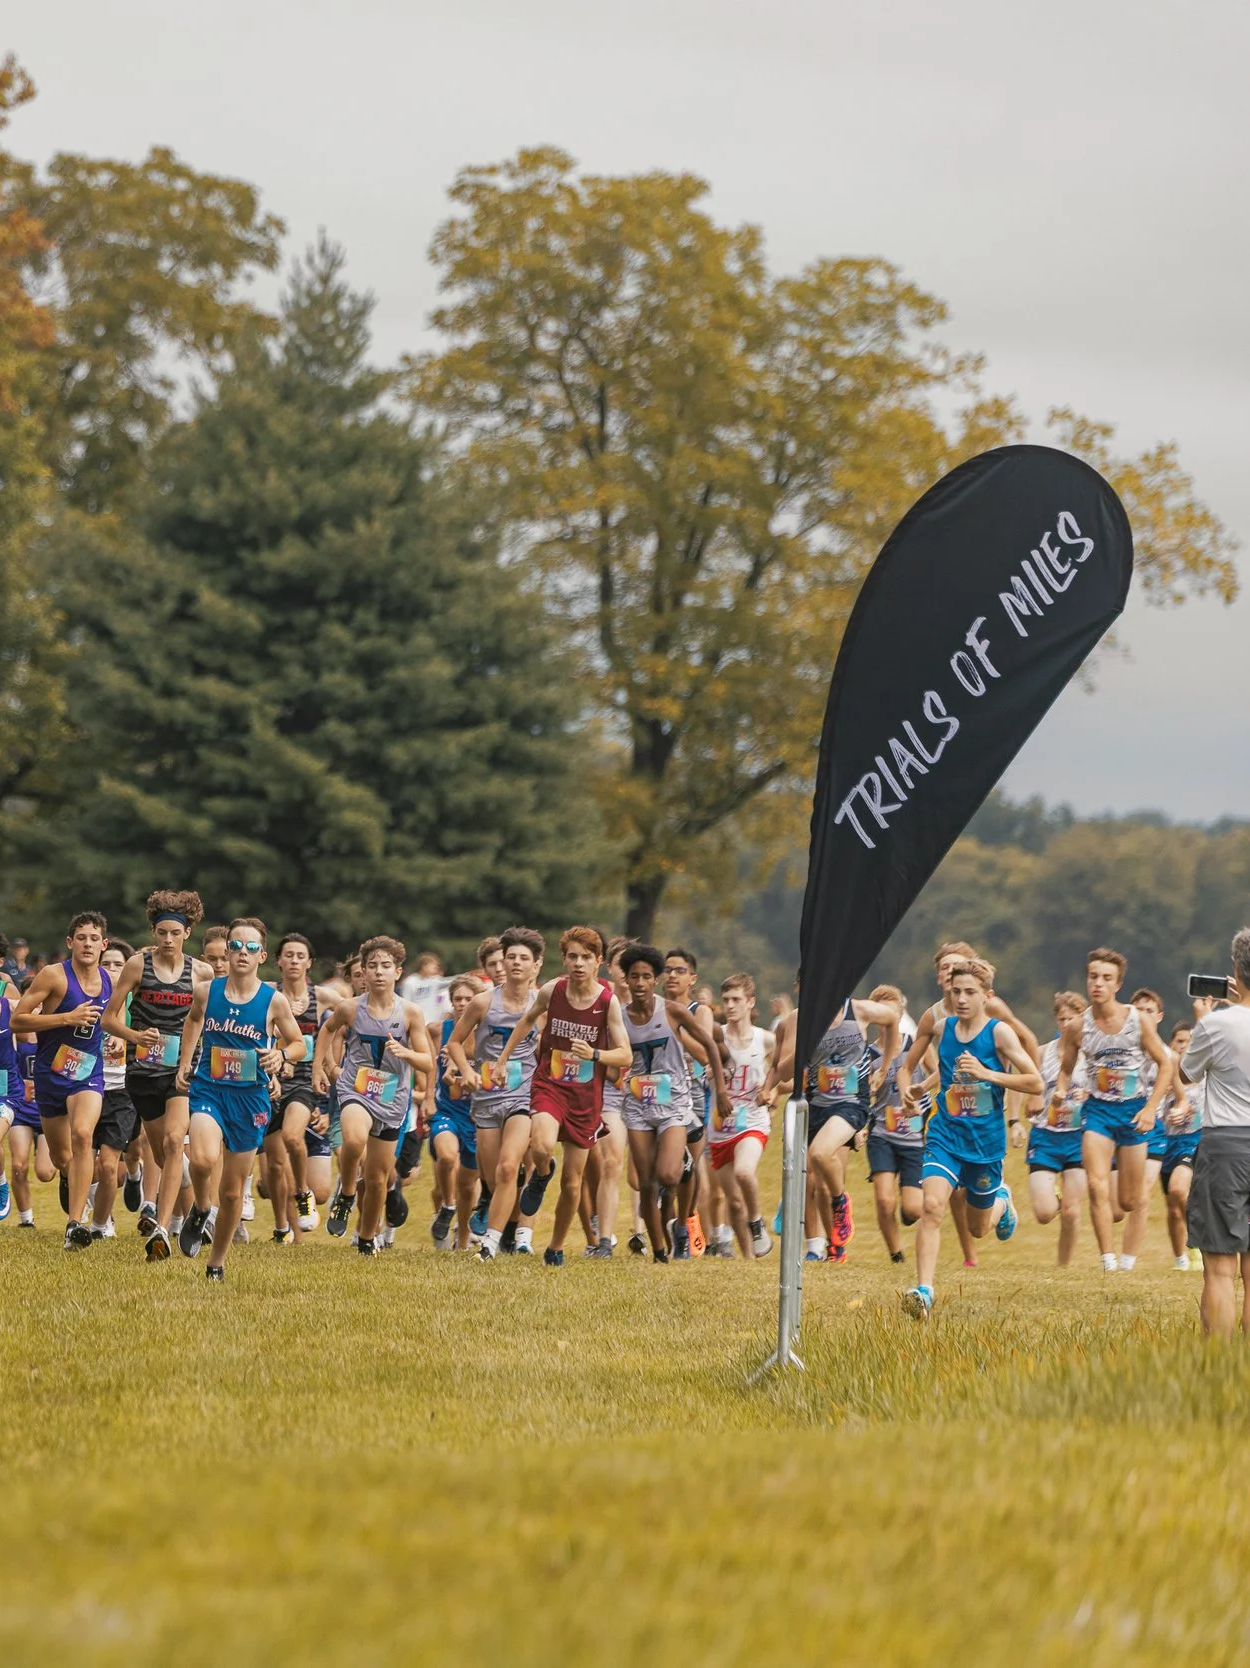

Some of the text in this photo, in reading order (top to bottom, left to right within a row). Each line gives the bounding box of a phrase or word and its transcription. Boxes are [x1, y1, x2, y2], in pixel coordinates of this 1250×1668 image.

[834, 511, 1095, 849] TRIALS OF MILES
[140, 989, 193, 1007] HERITAGE
[205, 1017, 262, 1041] DeMatha
[550, 1026, 598, 1042] FRIENDS
[551, 1018, 599, 1035] SIDWELL
[148, 1044, 165, 1057] 394
[64, 1058, 81, 1073] 304
[224, 1061, 242, 1074] 149
[564, 1063, 580, 1076] 731
[367, 1080, 385, 1095] 868
[960, 1096, 977, 1109] 102
